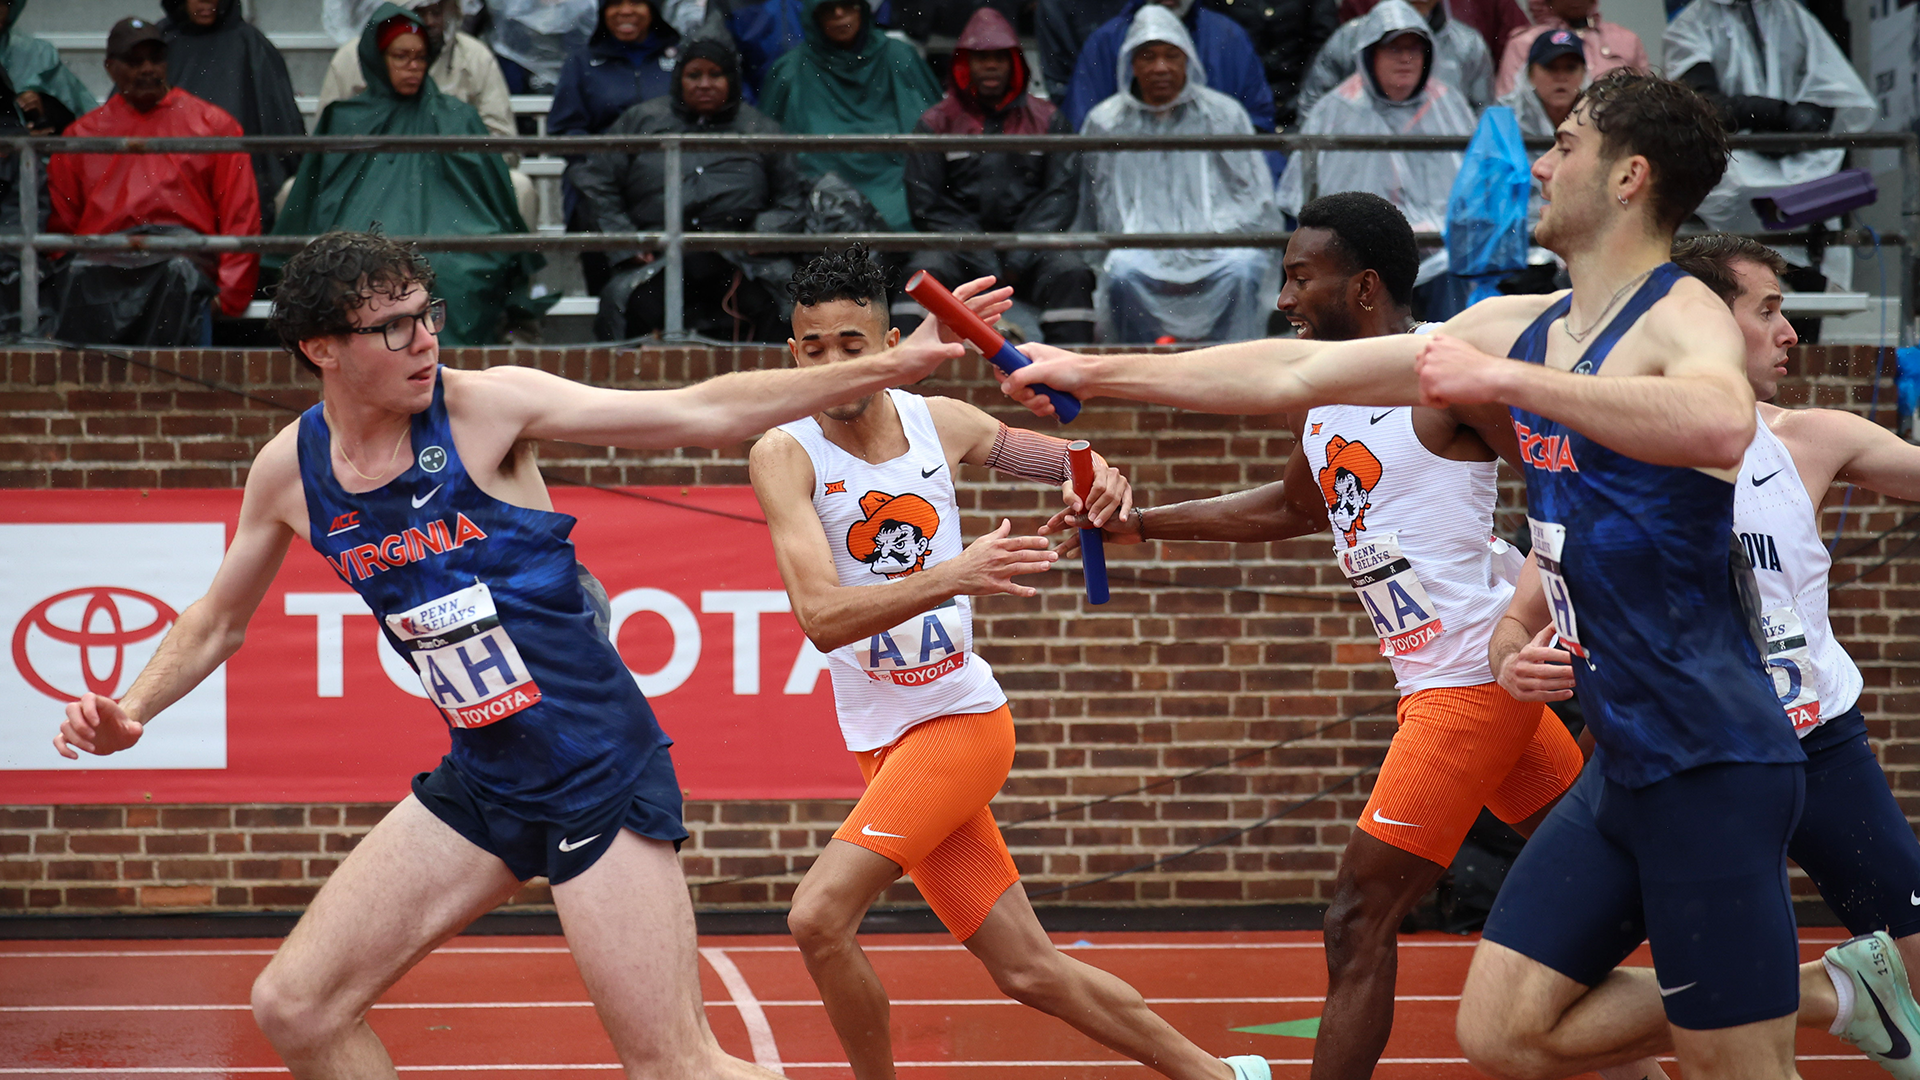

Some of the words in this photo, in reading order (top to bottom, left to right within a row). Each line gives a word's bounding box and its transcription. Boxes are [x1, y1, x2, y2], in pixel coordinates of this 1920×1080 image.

[328, 510, 360, 532] ACC
[326, 511, 488, 584] VIRGINIA
[1356, 550, 1391, 571] RELAYS
[420, 598, 459, 623] PENN
[423, 605, 476, 632] RELAYS
[1362, 579, 1430, 635] AA
[869, 614, 956, 668] AA
[1391, 626, 1437, 653] TOYOTA
[426, 634, 518, 705] AH
[894, 659, 956, 684] TOYOTA
[460, 690, 531, 725] TOYOTA
